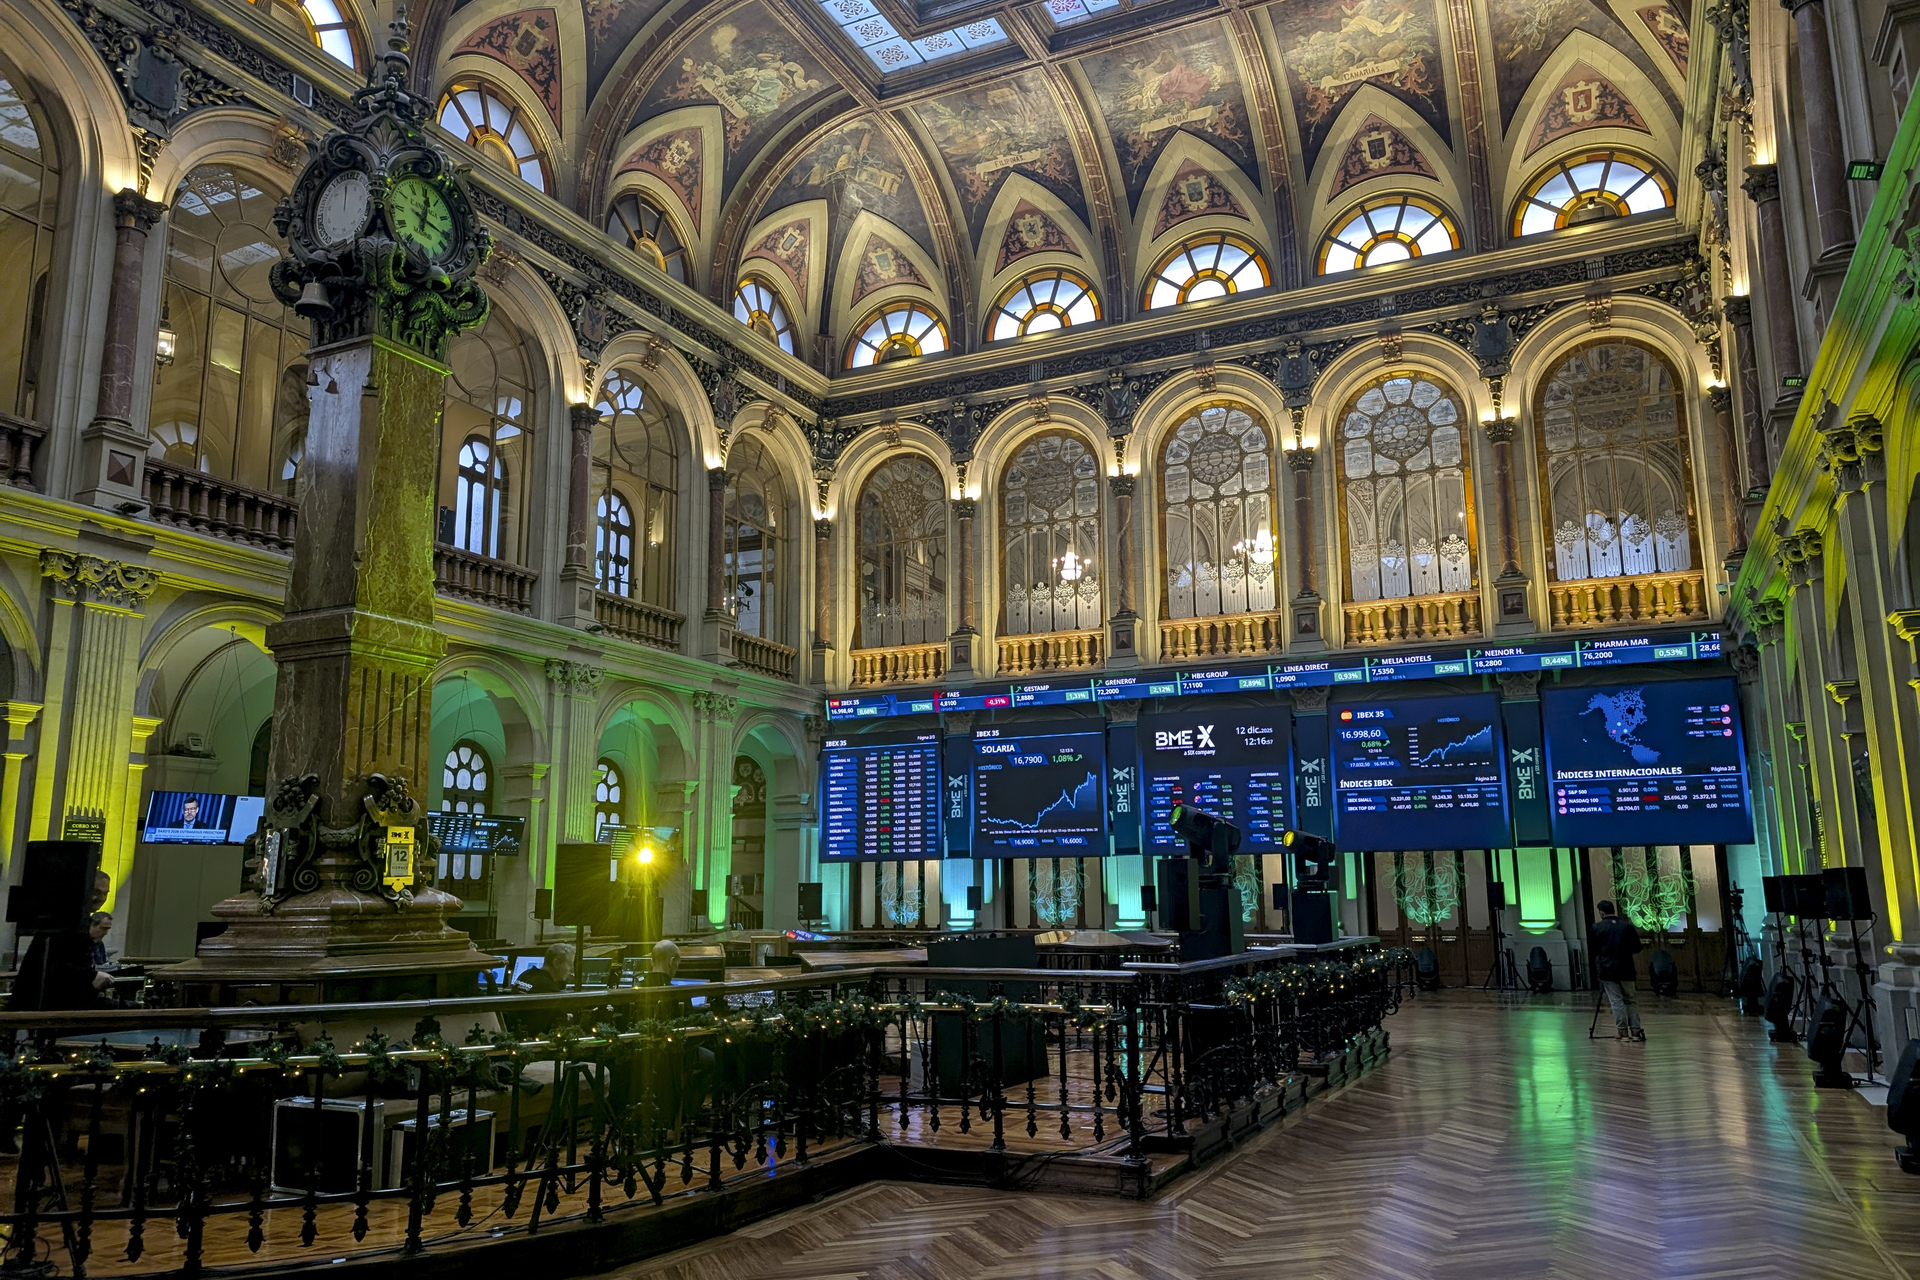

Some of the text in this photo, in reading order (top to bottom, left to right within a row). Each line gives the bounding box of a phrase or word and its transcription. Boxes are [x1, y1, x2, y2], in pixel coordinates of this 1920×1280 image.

[712, 88, 735, 110] GRANADA
[1405, 655, 1432, 663] HOTELS
[1584, 652, 1612, 660] 76,2000
[1156, 730, 1193, 746] BME
[1342, 730, 1380, 738] 16.998,60
[982, 745, 1015, 753] SOLARIA
[1014, 756, 1042, 764] 16,7900
[1557, 767, 1682, 779] ÍNDICES INTERNACIONALES
[1340, 780, 1372, 788] ÍNDICES
[1516, 767, 1532, 799] BME
[1305, 776, 1318, 806] BME
[951, 790, 960, 818] BME
[1116, 784, 1128, 812] BME
[394, 850, 408, 862] 12
